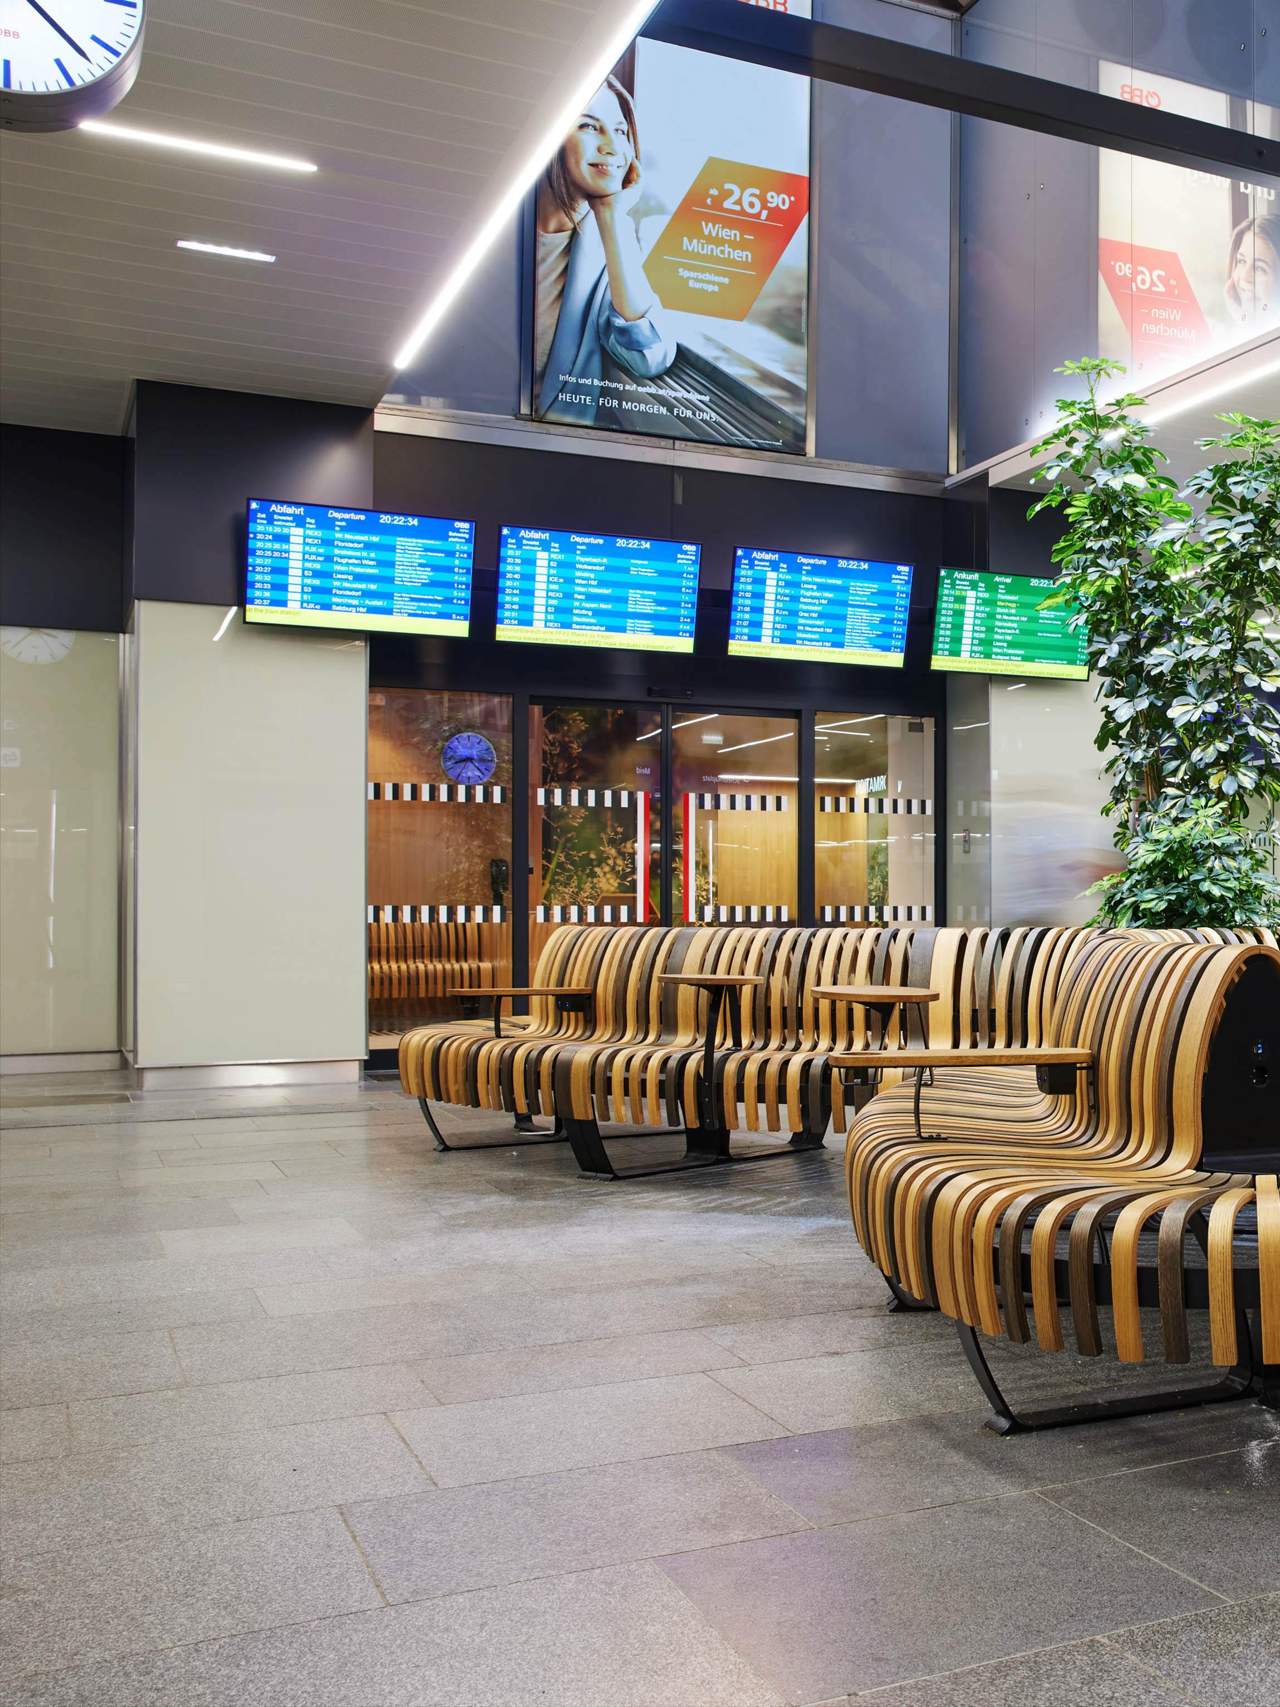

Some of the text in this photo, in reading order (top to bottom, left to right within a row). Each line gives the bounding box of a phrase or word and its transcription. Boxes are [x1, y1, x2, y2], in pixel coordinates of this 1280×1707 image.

[701, 221, 740, 241] Wien
[682, 236, 752, 263] München
[677, 267, 730, 285] Sparschiene
[688, 279, 720, 292] Europa
[559, 374, 577, 383] Infos
[578, 377, 592, 386] und
[593, 379, 624, 391] Buchung
[558, 392, 596, 406] HEUTE.
[599, 397, 619, 408] FÜR
[622, 402, 671, 416] MORGEN.
[673, 407, 693, 418] FÜR
[270, 504, 304, 515] Abfahrt
[328, 510, 365, 521] Departure
[379, 514, 418, 526] 20:22:34
[519, 530, 650, 549] Abfahrt Departure 20:22:34
[752, 551, 869, 570] Abfahrt Departure 20:22:34
[953, 571, 979, 580] Ankunft
[1030, 578, 1054, 588] 20:22:
